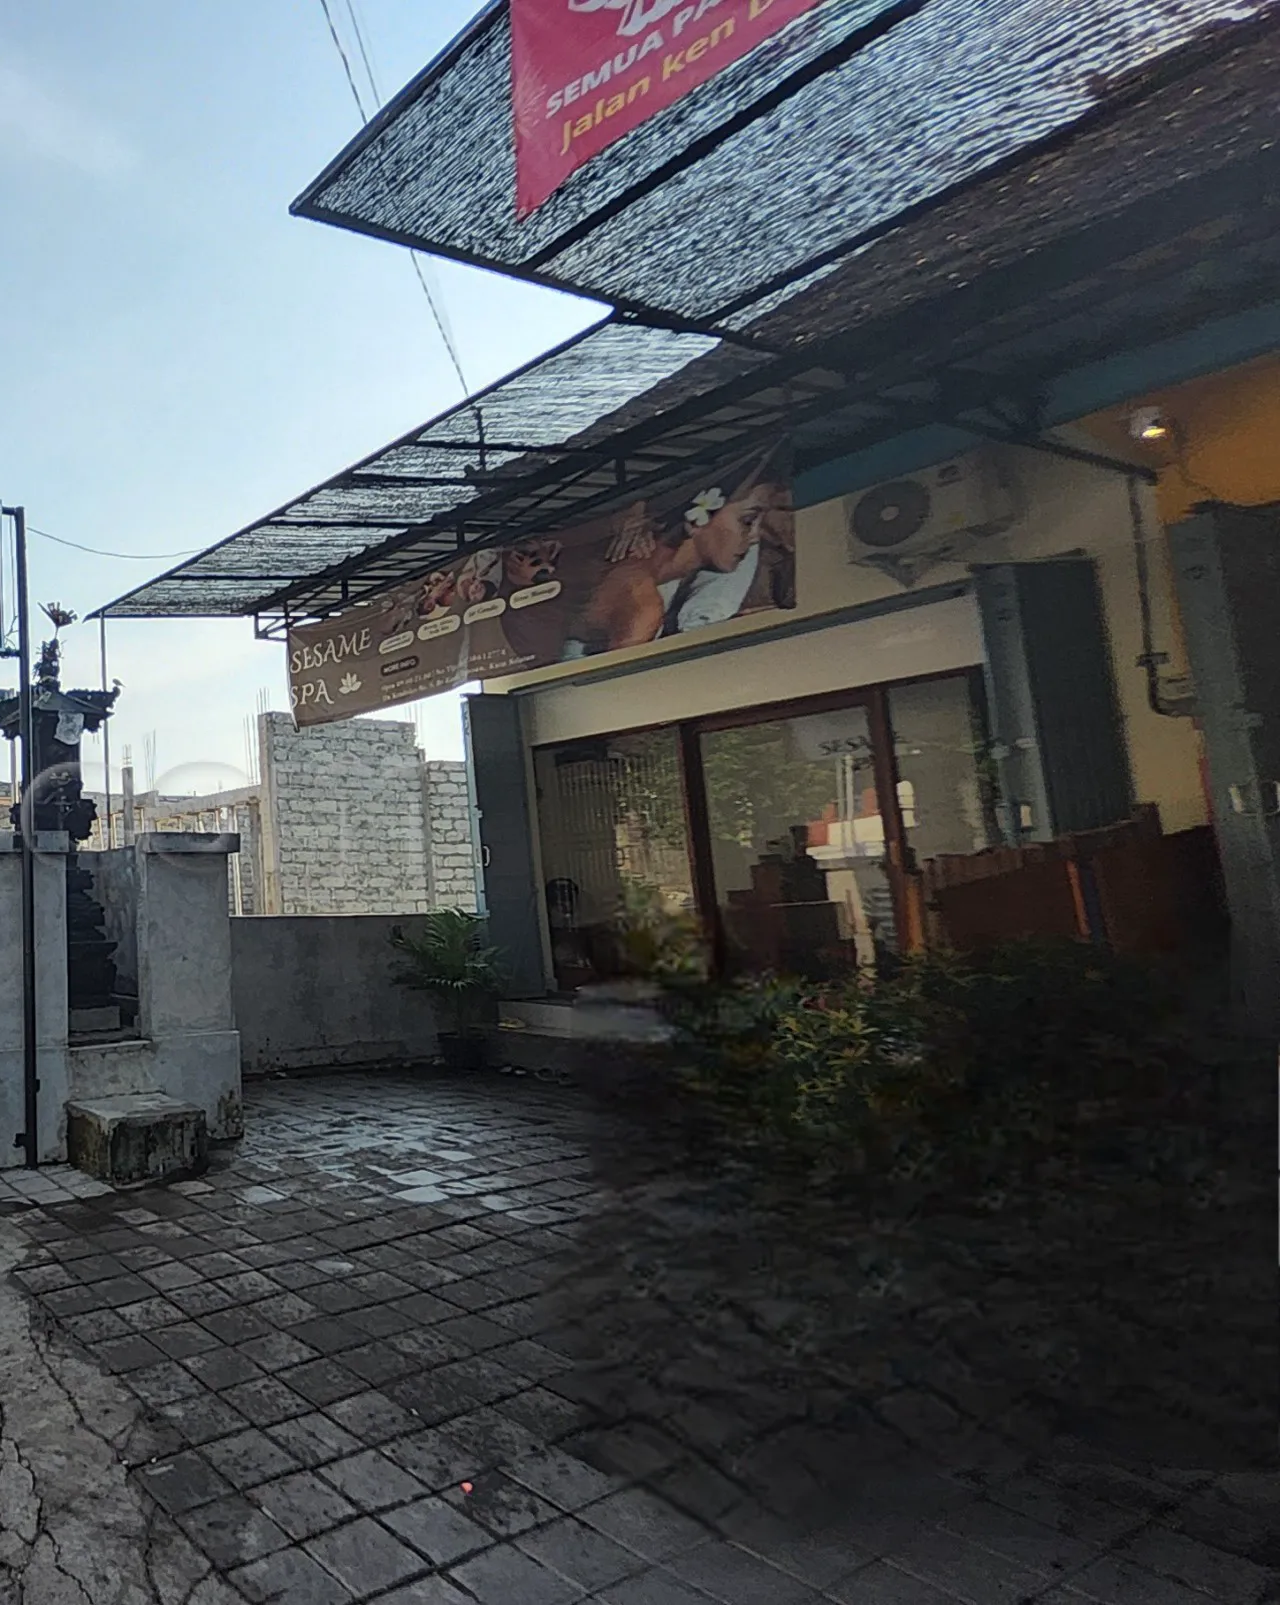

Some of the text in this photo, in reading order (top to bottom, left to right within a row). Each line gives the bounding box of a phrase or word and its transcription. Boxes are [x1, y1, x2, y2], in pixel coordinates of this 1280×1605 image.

[545, 29, 664, 119] SEMUA
[560, 76, 651, 156] Jalan
[662, 16, 737, 82] ken
[290, 627, 372, 674] SESAME
[290, 678, 335, 709] SPA
